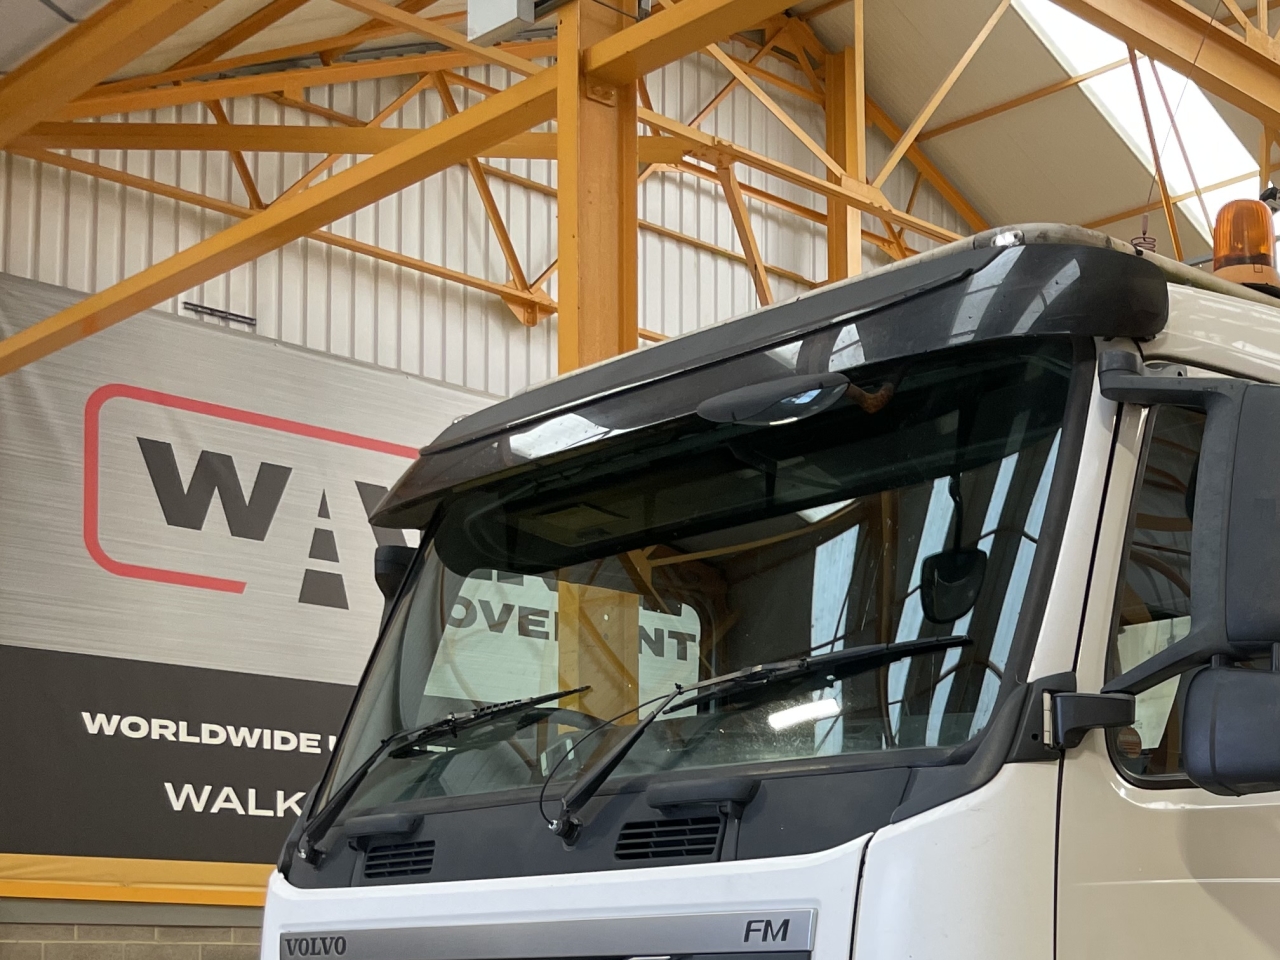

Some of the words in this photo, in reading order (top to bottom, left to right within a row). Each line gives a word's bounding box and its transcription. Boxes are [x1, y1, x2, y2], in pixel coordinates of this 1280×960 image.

[81, 711, 322, 754] WORLDWIDE
[164, 781, 307, 818] WALK
[284, 935, 347, 957] VOLVO
[743, 918, 791, 943] FM
